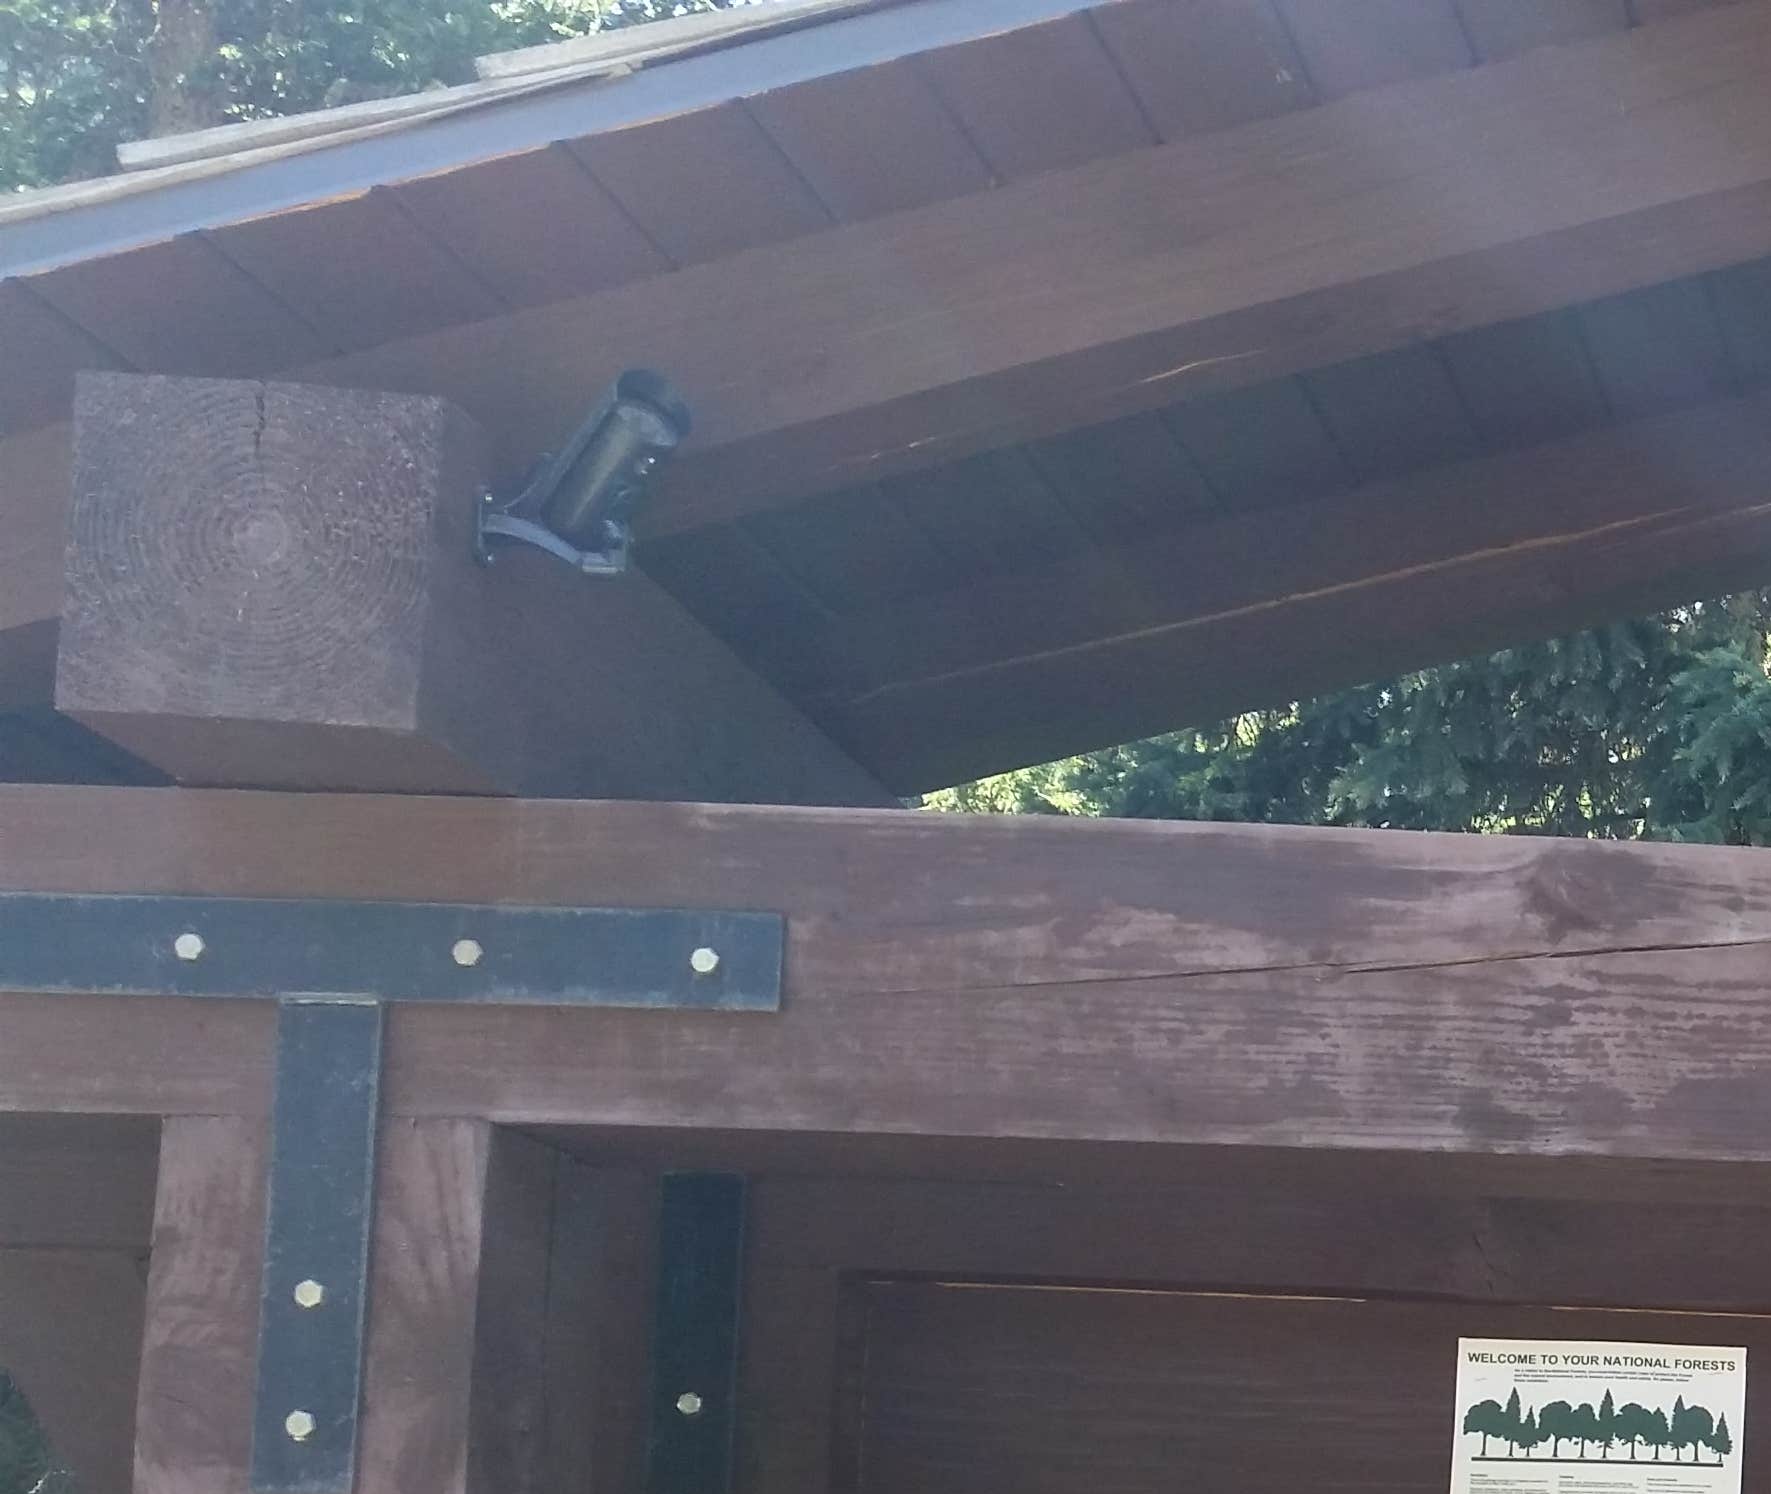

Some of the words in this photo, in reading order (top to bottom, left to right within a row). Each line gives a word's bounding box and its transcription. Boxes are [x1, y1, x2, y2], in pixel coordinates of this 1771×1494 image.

[1468, 1352, 1537, 1366] WELCOME
[1540, 1354, 1558, 1365] TO
[1562, 1353, 1600, 1367] YOUR
[1603, 1355, 1671, 1369] NATIONAL
[1674, 1359, 1735, 1372] FORESTS
